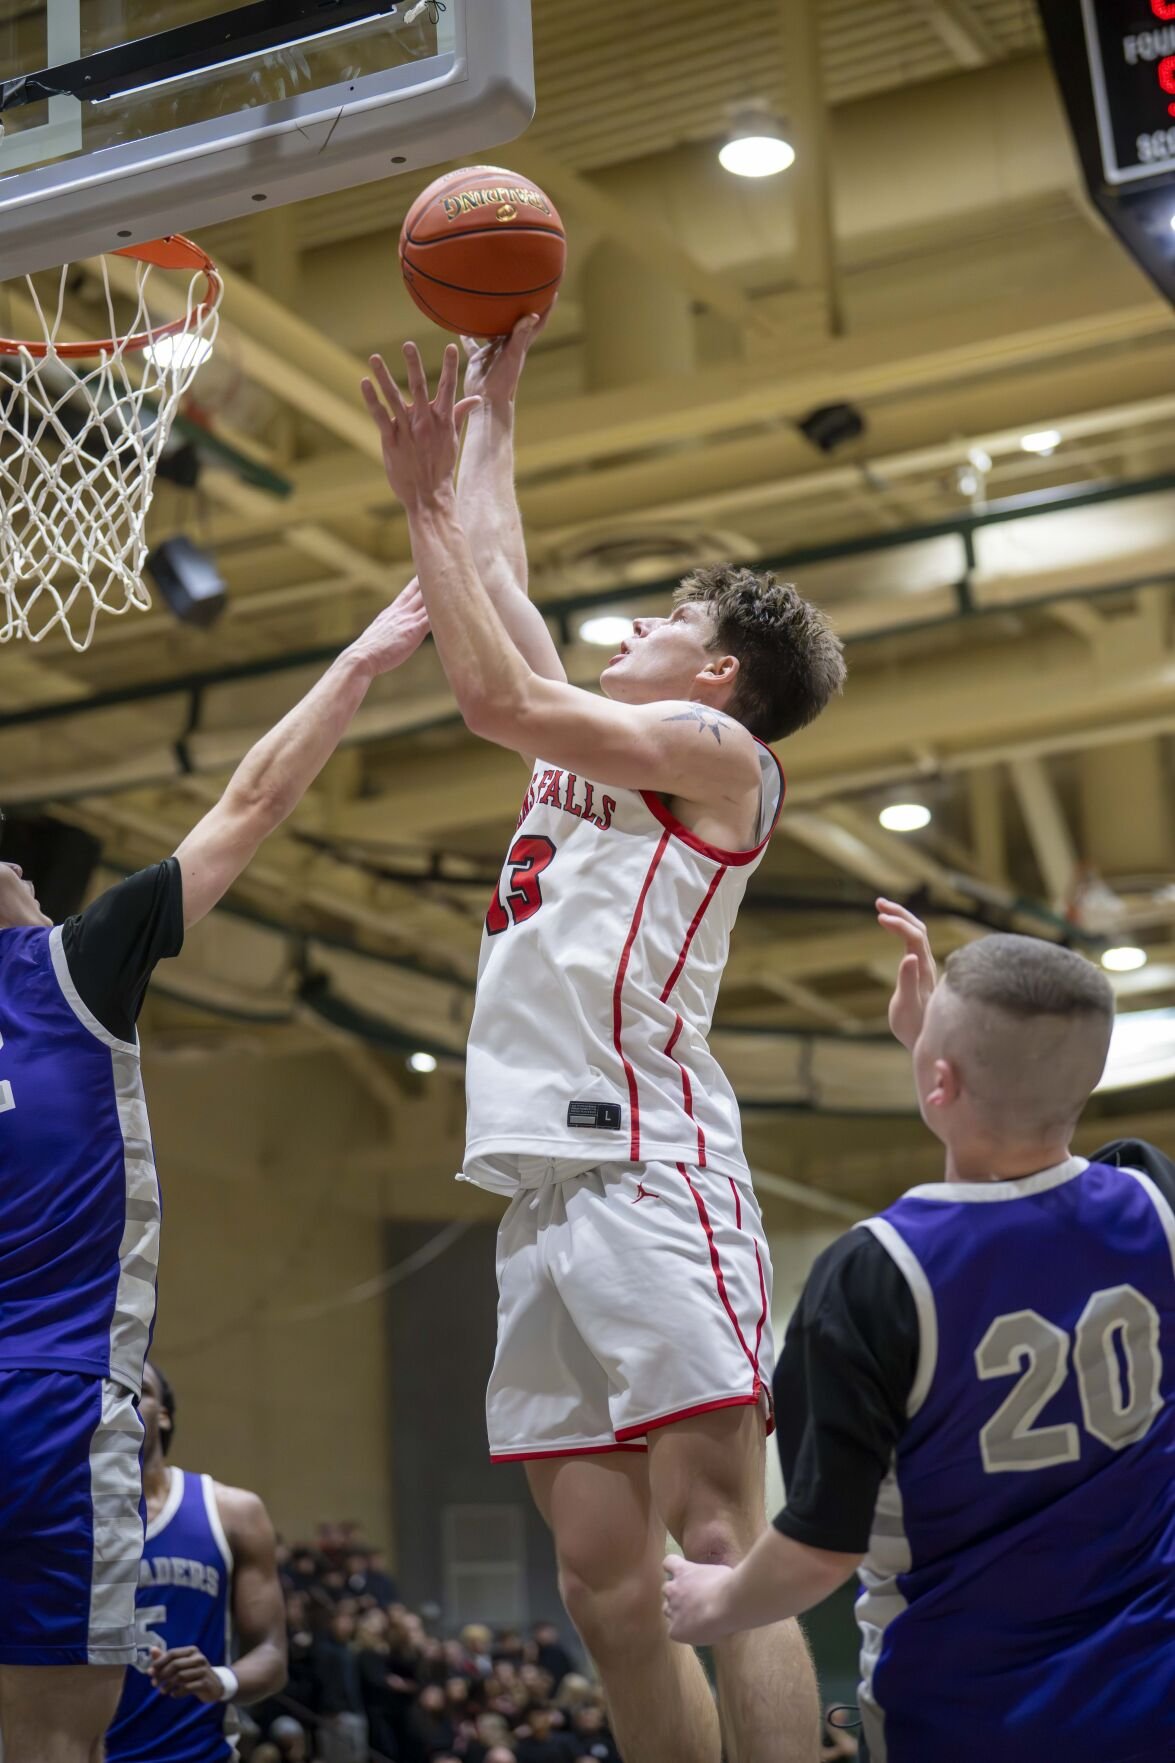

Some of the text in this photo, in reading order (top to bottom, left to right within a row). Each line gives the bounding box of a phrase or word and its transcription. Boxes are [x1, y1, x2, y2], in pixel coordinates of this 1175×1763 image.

[535, 769, 616, 831] FALLS
[486, 835, 557, 936] 13
[605, 1110, 611, 1121] L
[974, 1283, 1164, 1473] 20
